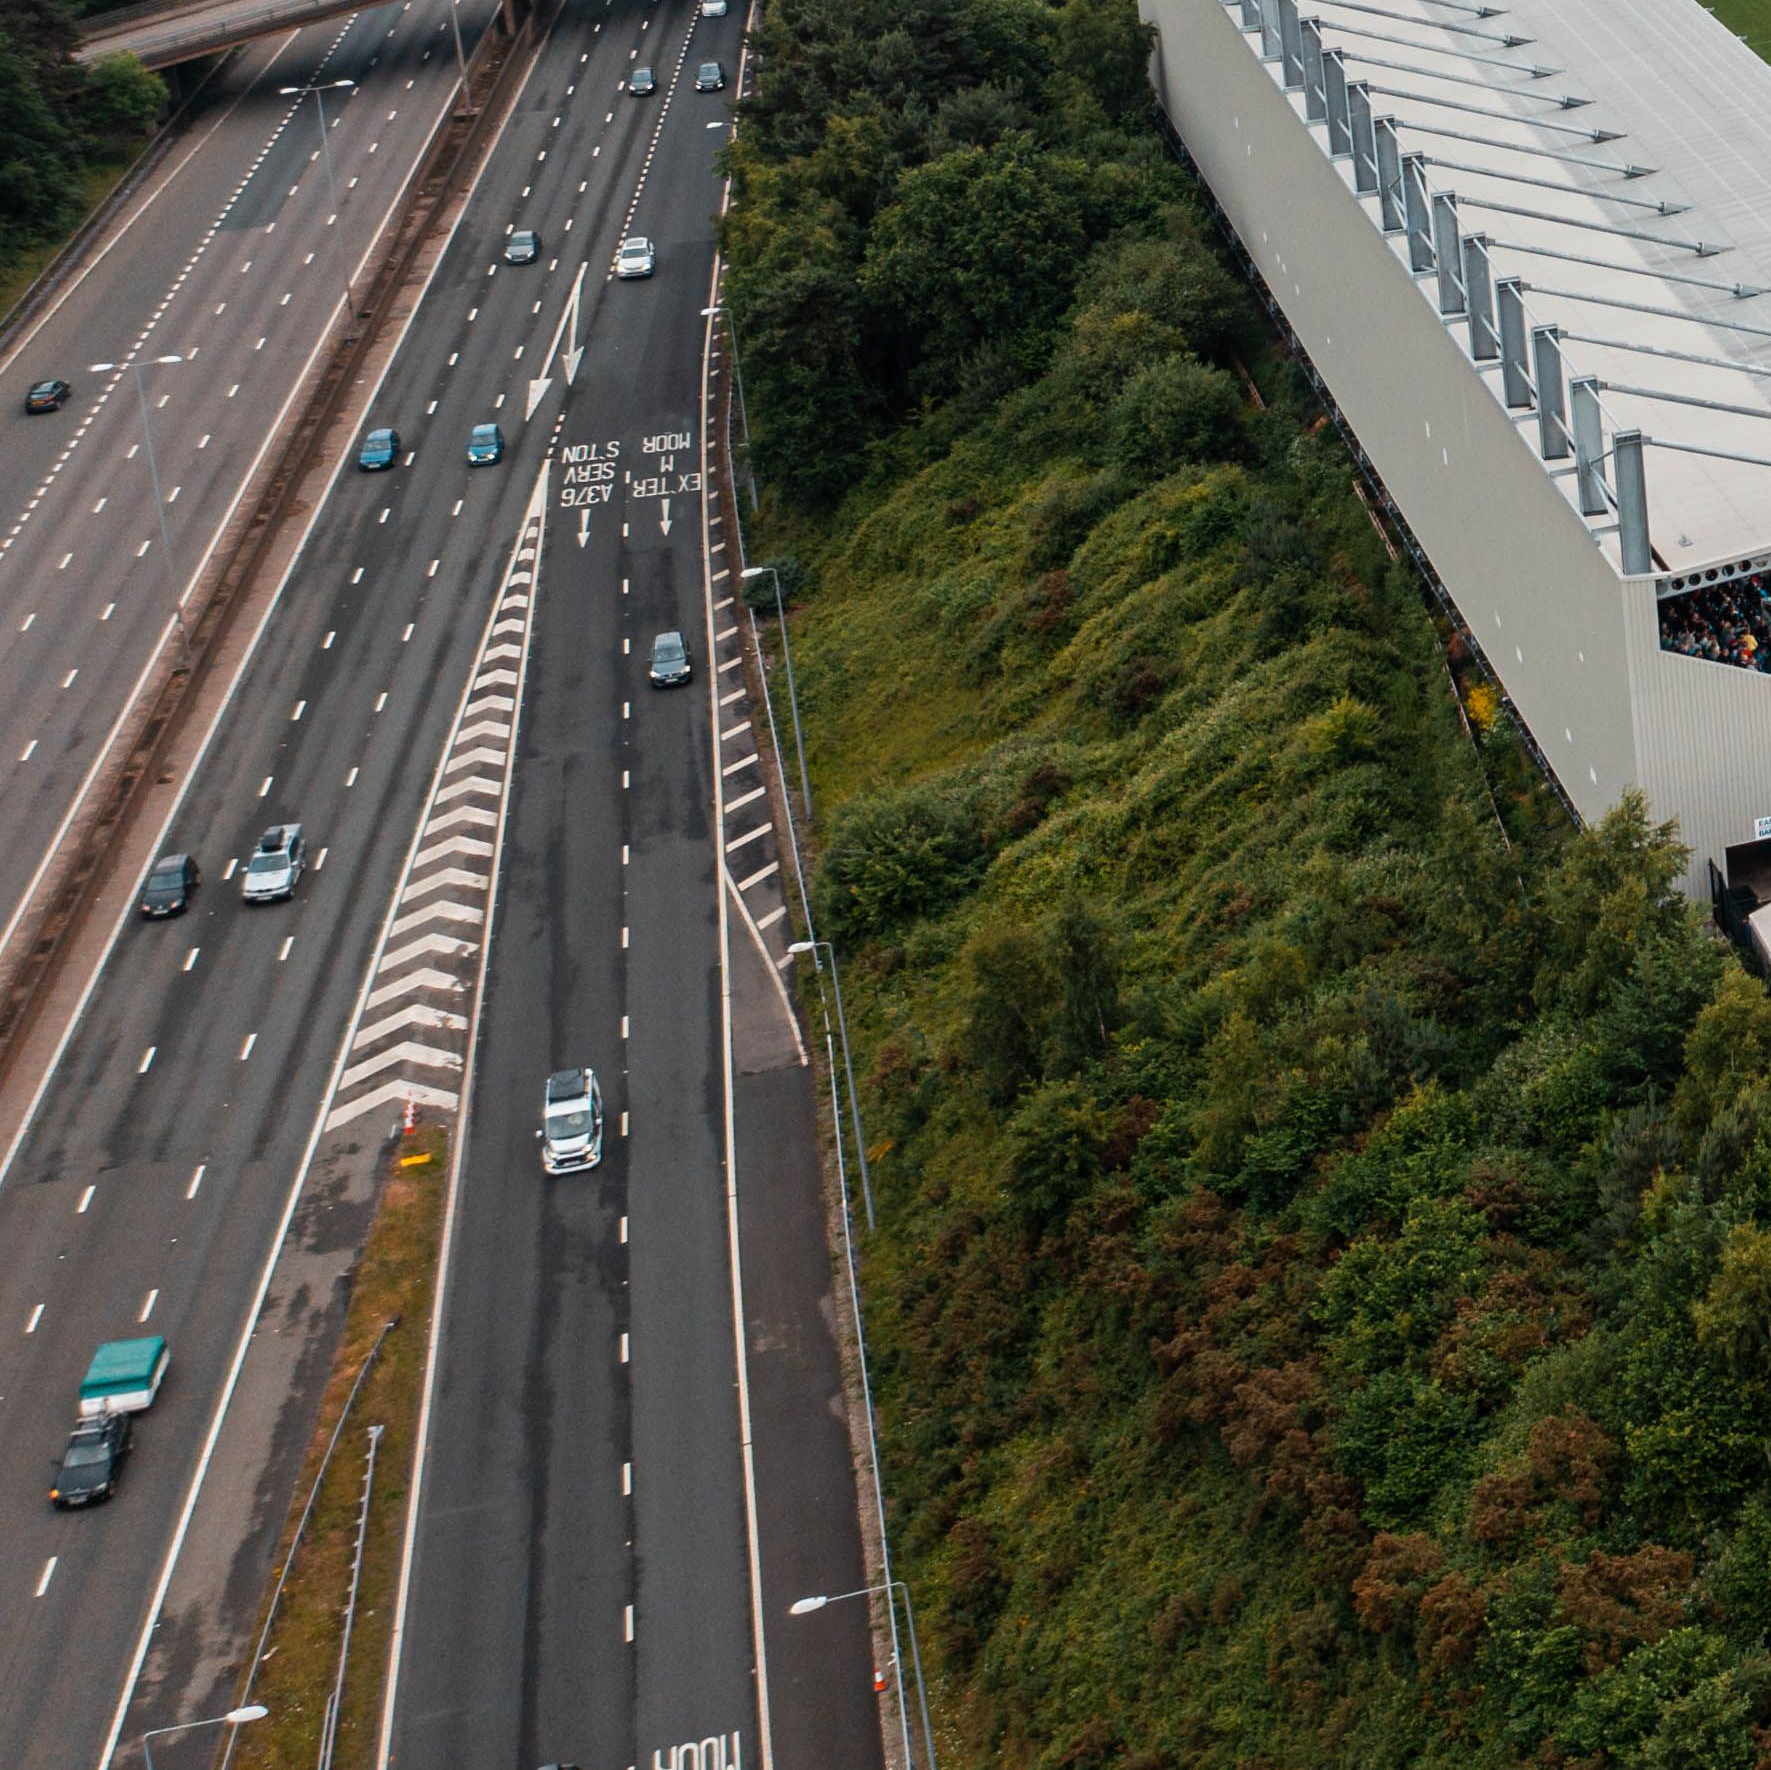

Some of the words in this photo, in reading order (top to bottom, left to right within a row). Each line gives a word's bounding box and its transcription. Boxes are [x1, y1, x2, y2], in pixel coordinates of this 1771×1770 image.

[642, 432, 691, 453] MOOR
[563, 462, 616, 485] SERV
[660, 454, 674, 473] M
[560, 483, 613, 507] A376
